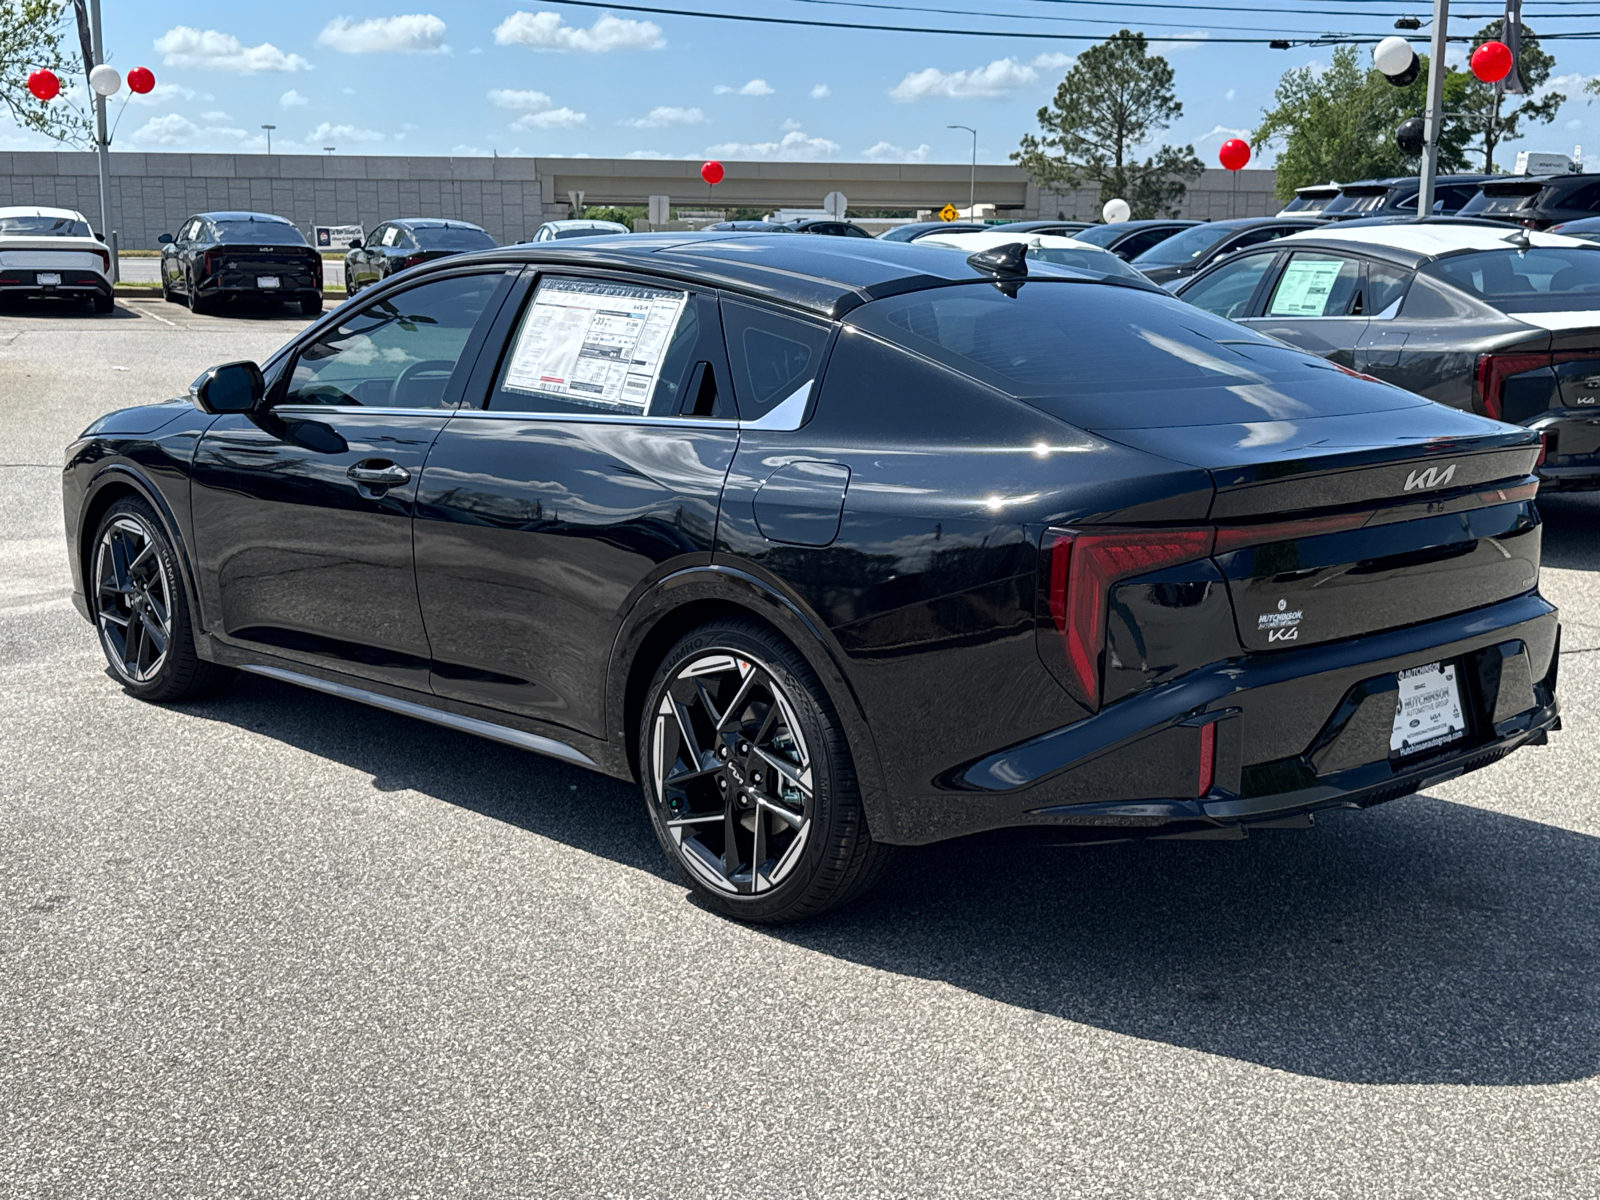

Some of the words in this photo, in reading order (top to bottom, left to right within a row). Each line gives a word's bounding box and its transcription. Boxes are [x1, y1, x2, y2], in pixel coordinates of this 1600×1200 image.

[1403, 464, 1456, 491] KIA
[162, 548, 178, 601] KUMHO
[1258, 611, 1303, 623] HUTCHINSON
[1268, 627, 1298, 642] K4
[662, 638, 703, 676] KUMHO
[1405, 662, 1440, 679] HUTCHINSON
[1404, 688, 1450, 710] HUTCHINSON
[1406, 704, 1434, 717] AUTOMOTIVE
[1435, 699, 1449, 708] GROUP
